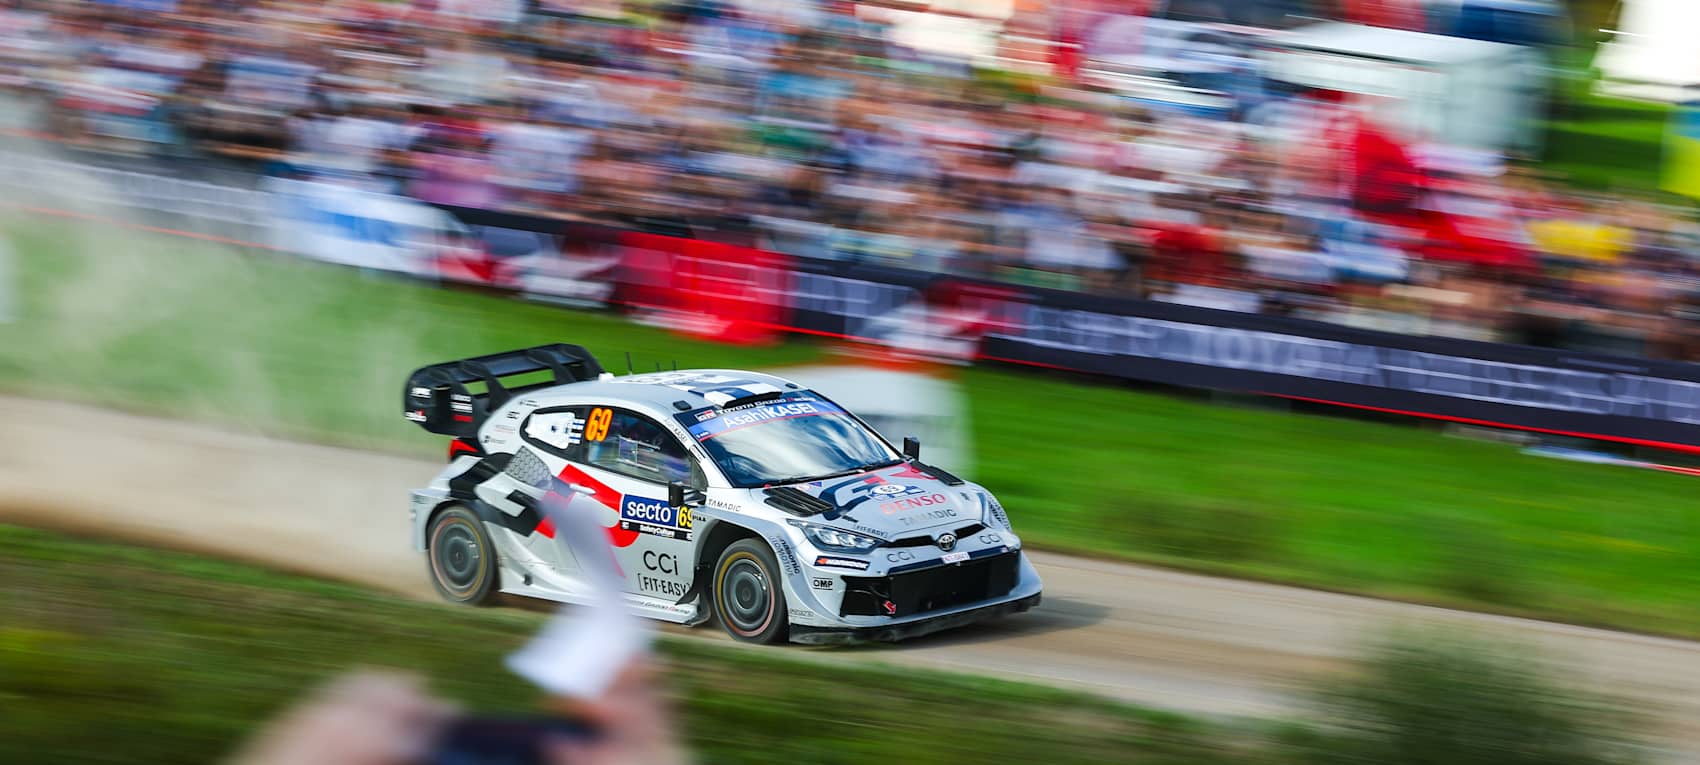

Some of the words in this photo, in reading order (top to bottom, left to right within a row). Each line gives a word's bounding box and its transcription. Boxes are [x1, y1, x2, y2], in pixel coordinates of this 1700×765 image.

[716, 403, 754, 414] TOYOTA
[723, 402, 819, 428] AsahiKASEI
[585, 407, 614, 442] 69
[626, 501, 672, 523] secto
[679, 506, 693, 527] 69
[706, 498, 742, 512] TAMADIC
[879, 493, 946, 516] DENSO
[899, 509, 957, 527] TAMADIC
[643, 550, 678, 576] CCi
[813, 579, 834, 588] OMP
